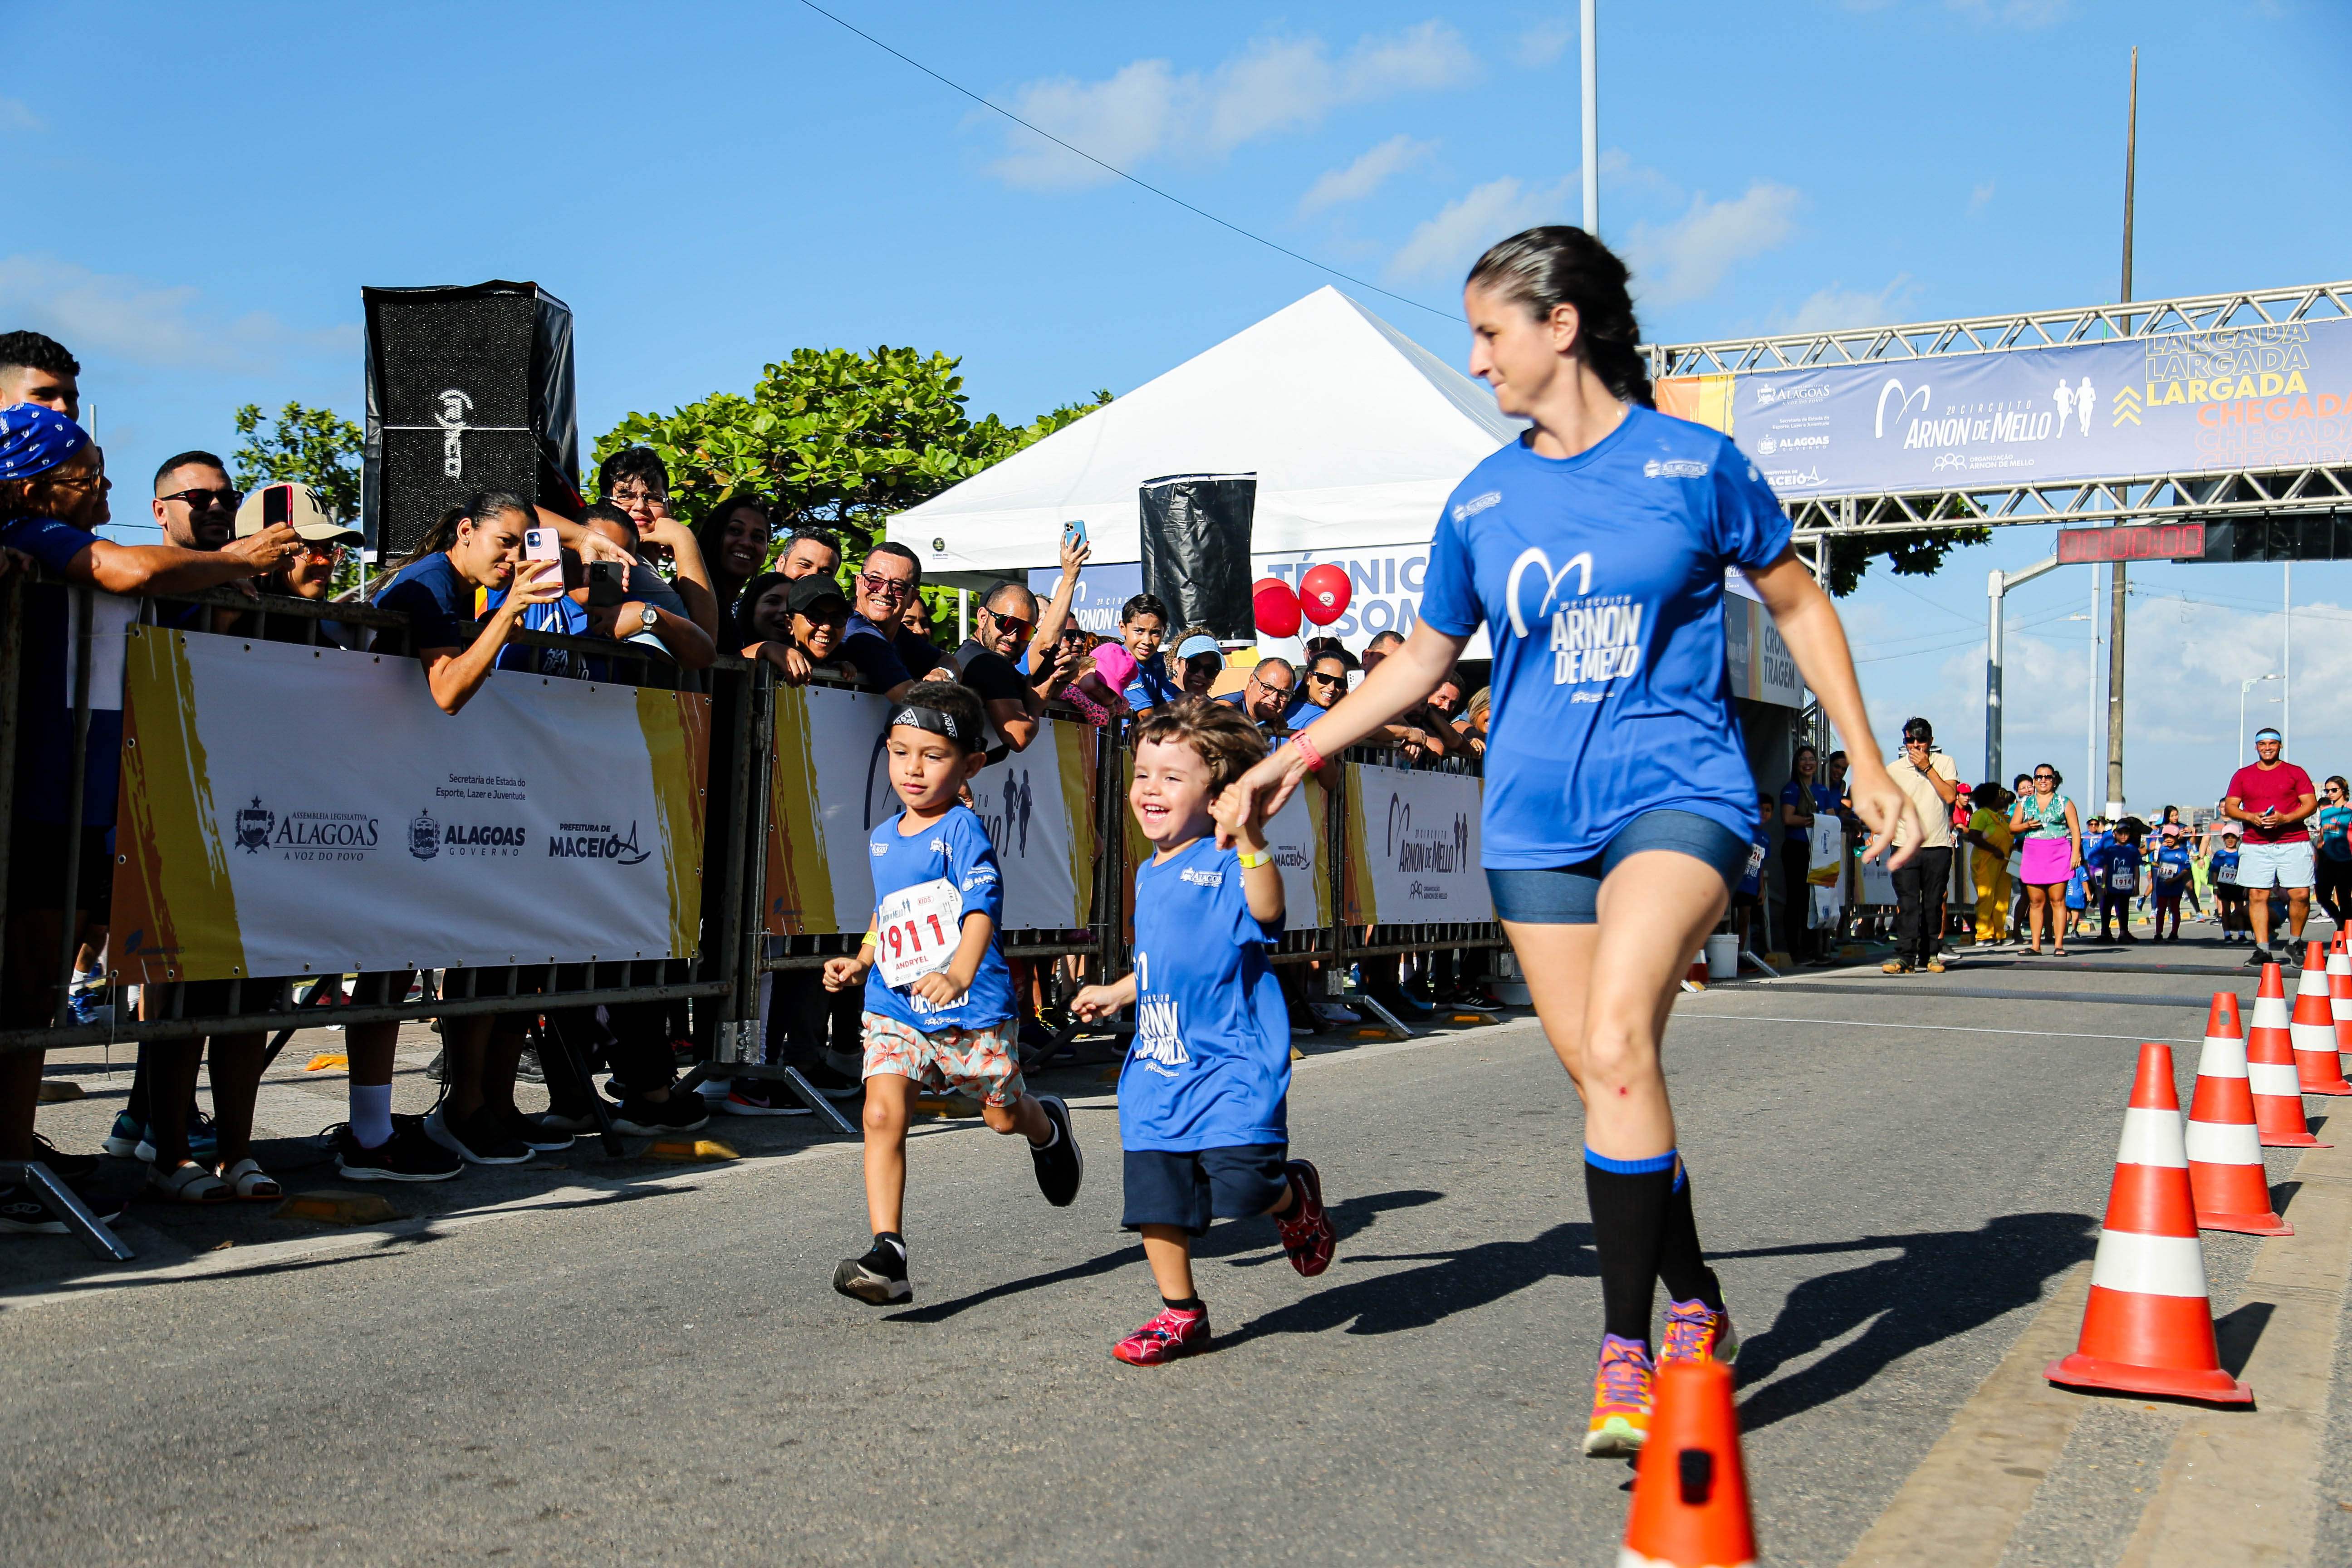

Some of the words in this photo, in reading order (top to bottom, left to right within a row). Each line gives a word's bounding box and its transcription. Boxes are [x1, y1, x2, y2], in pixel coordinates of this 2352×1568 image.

[2146, 324, 2310, 356] LARGADA
[2146, 344, 2310, 383] LARGADA
[1777, 385, 1830, 400] ALAGOAS
[2147, 371, 2308, 407] LARGADA
[1960, 400, 2032, 415] CIRCUITO
[1903, 417, 1971, 450] ARNON
[1972, 419, 1991, 441] DE
[1990, 411, 2052, 443] MELLO
[1779, 436, 1830, 448] ALAGOAS
[1969, 453, 2014, 462] ORGANIZAÇÃO
[1969, 461, 1997, 470] ARNON
[2009, 459, 2035, 467] MELLO
[1662, 463, 1708, 475] ALAGOAS
[1765, 472, 1807, 486] ACEIÓ
[1073, 608, 1114, 631] ARNON
[1550, 603, 1642, 652] ARNON
[1553, 650, 1582, 685] DE
[1764, 656, 1795, 690] TRAGEM
[449, 774, 484, 784] Secretaria
[486, 776, 494, 785] de
[496, 776, 516, 786] Estada
[518, 778, 526, 787] do
[436, 787, 465, 799] Esporte,
[467, 789, 486, 798] Lazer
[493, 790, 526, 800] Juventude
[274, 815, 378, 846] ALAGOAS
[559, 823, 599, 832] PREFEITURA
[1421, 829, 1447, 840] CIRCUITO
[444, 825, 526, 847] ALAGOAS
[449, 847, 519, 857] GOVERNO
[549, 833, 621, 859] MACEIÓ
[295, 852, 314, 860] VOZ
[318, 852, 333, 861] DO
[337, 853, 364, 861] POVO
[1274, 850, 1301, 867] MACEIÓ
[1398, 839, 1425, 872] ARNON
[1425, 847, 1432, 868] DE
[1431, 840, 1454, 873] MELLO
[896, 956, 929, 970] ANDRYEL
